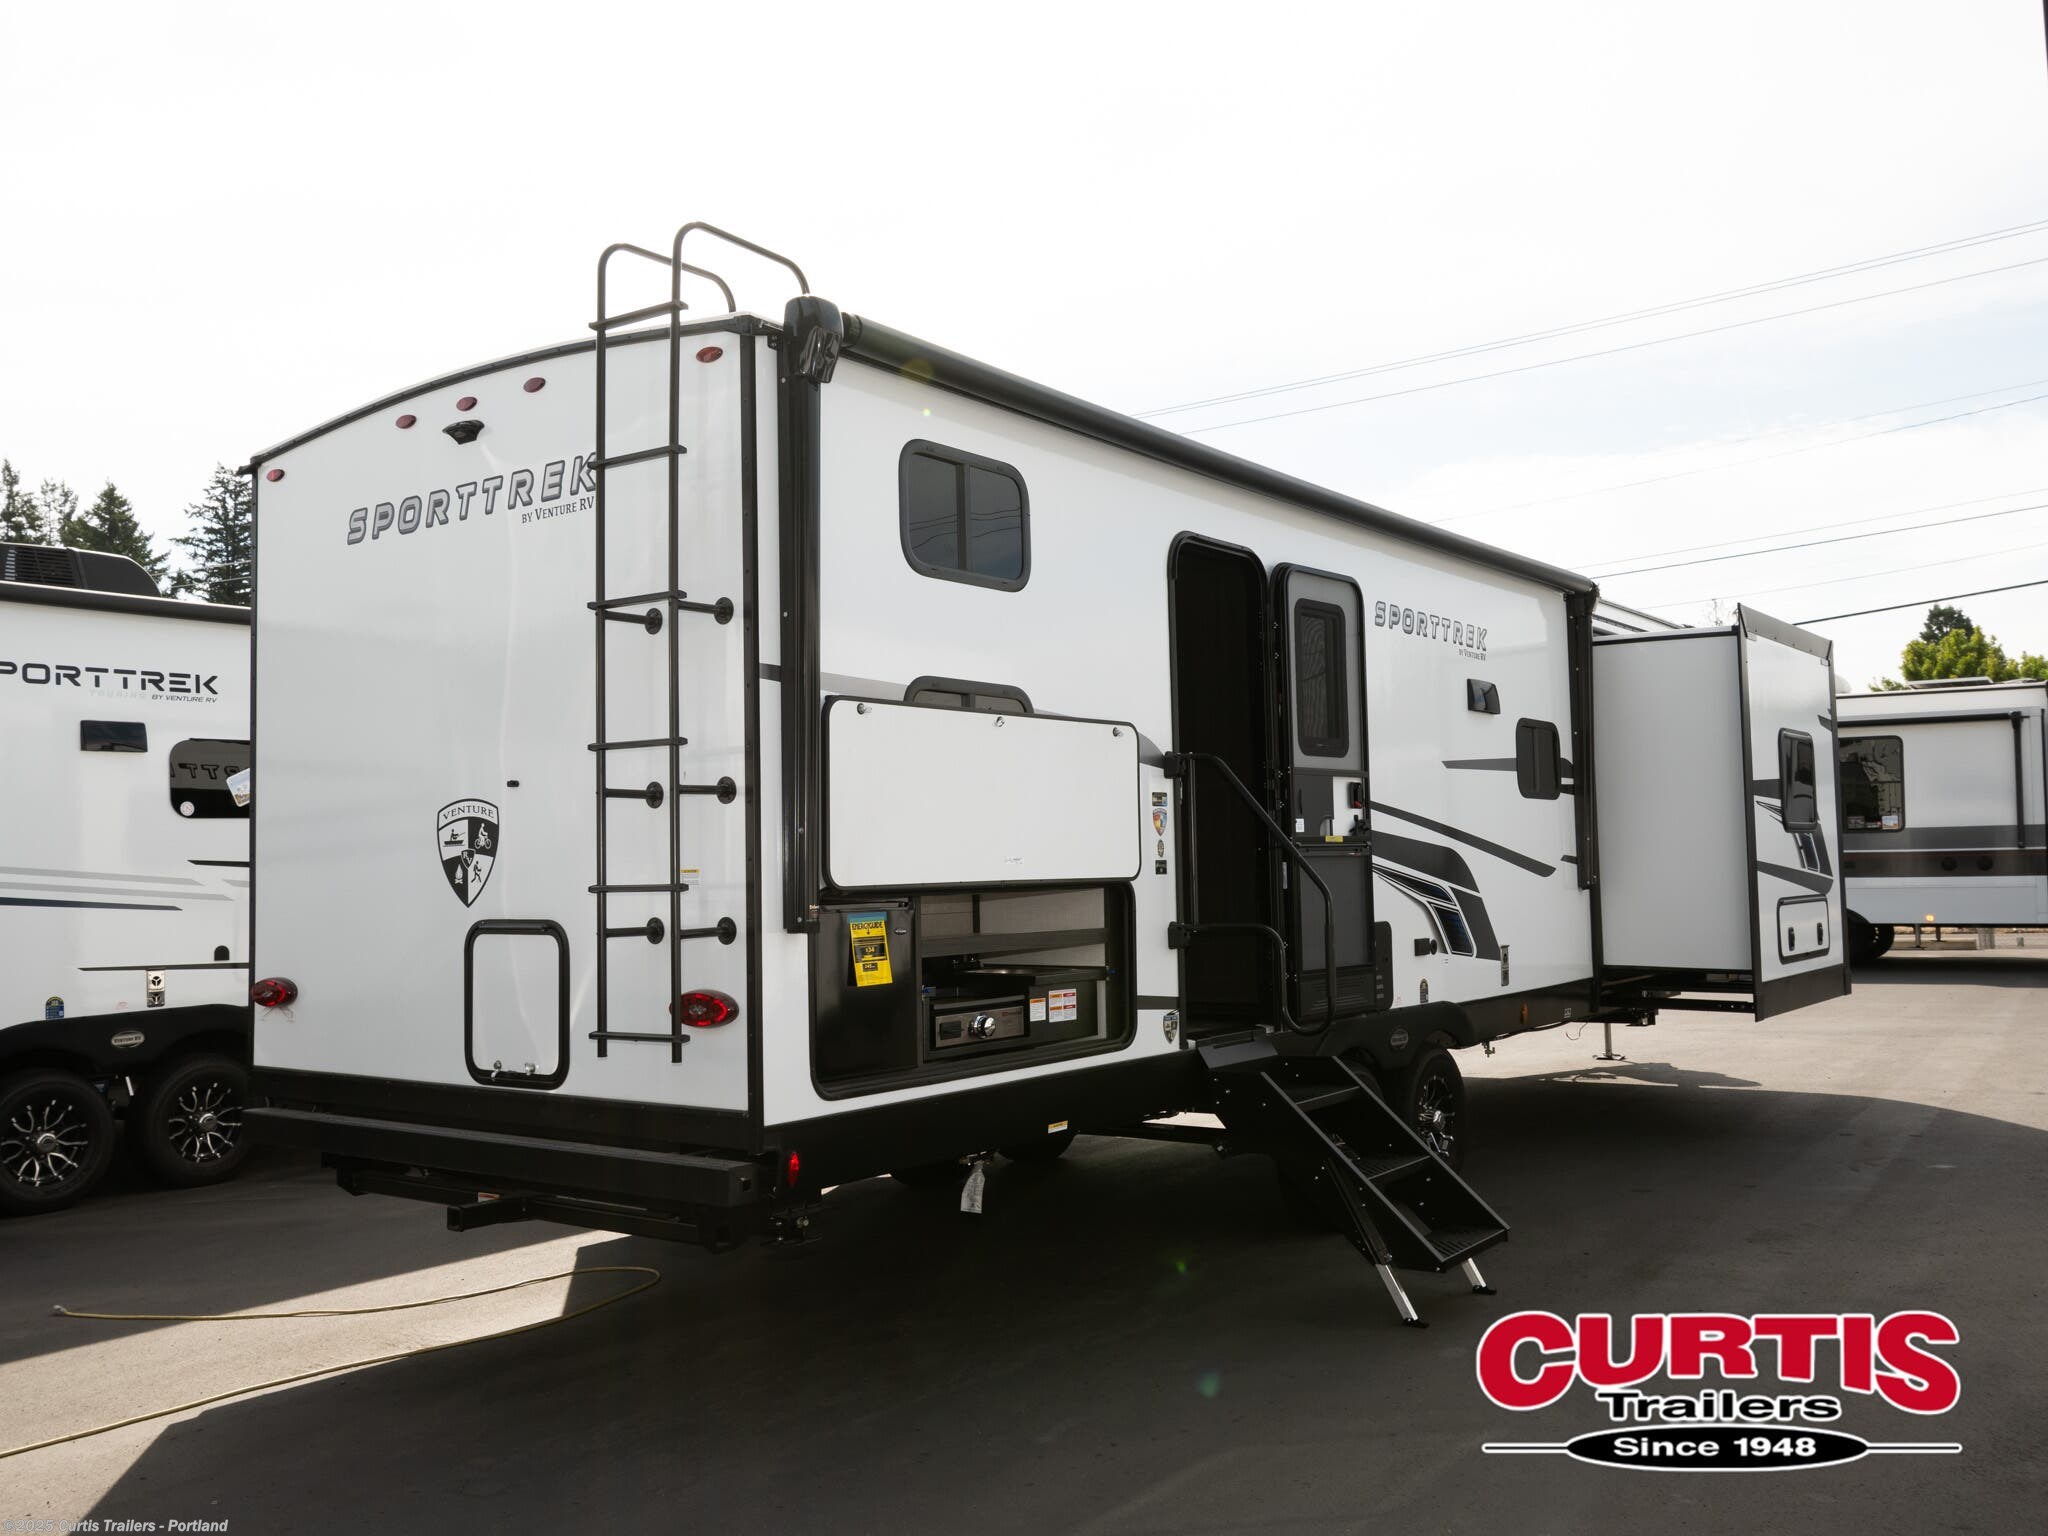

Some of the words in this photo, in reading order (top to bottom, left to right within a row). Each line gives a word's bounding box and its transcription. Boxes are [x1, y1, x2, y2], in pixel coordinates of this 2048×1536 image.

[347, 452, 596, 545] SPORTTREK
[579, 496, 594, 511] RV
[1374, 601, 1488, 651] SPORTTREK
[165, 694, 205, 703] VENTURE
[443, 805, 494, 820] VENTURE
